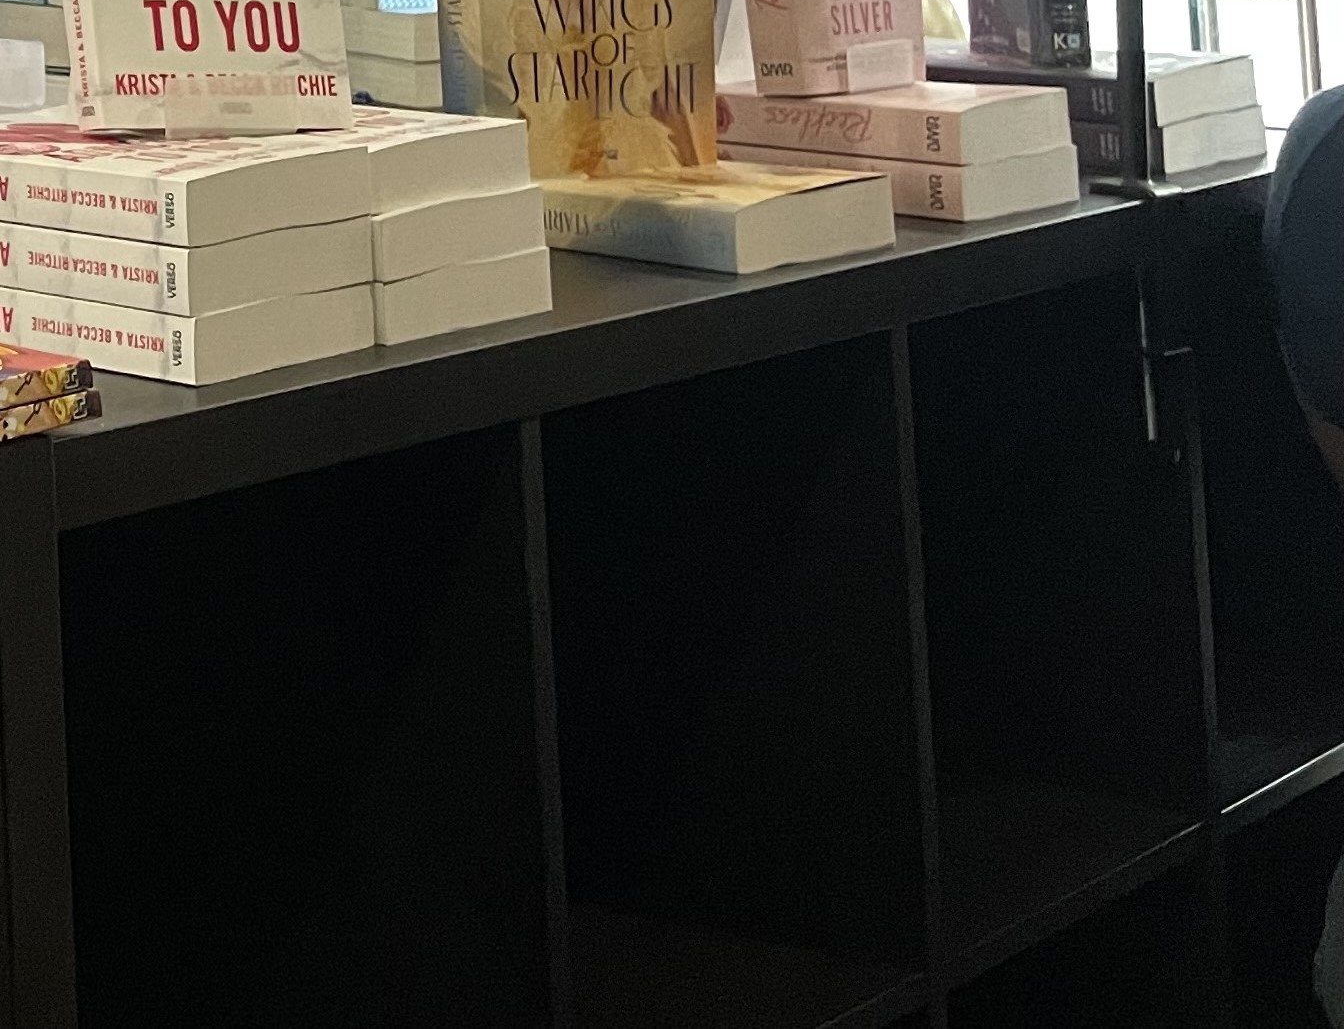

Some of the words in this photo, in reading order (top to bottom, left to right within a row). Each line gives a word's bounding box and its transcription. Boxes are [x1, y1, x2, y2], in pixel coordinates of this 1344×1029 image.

[143, 0, 200, 52] TO
[214, 0, 300, 53] YOU
[831, 0, 893, 36] SILVER
[591, 33, 634, 67] OF
[80, 57, 91, 99] KRISTA
[507, 51, 699, 118] STARLIGHT
[765, 106, 872, 143] Reckless
[27, 184, 68, 203] RITCHIE
[71, 190, 106, 209] BECCA
[120, 199, 158, 216] KRISTA
[28, 251, 69, 271] RITCHIE
[72, 258, 107, 277] BECCA
[122, 265, 160, 285] KRISTA
[31, 316, 73, 337] RITCHIE
[76, 324, 112, 344] BECCA
[127, 333, 165, 353] KRISTA
